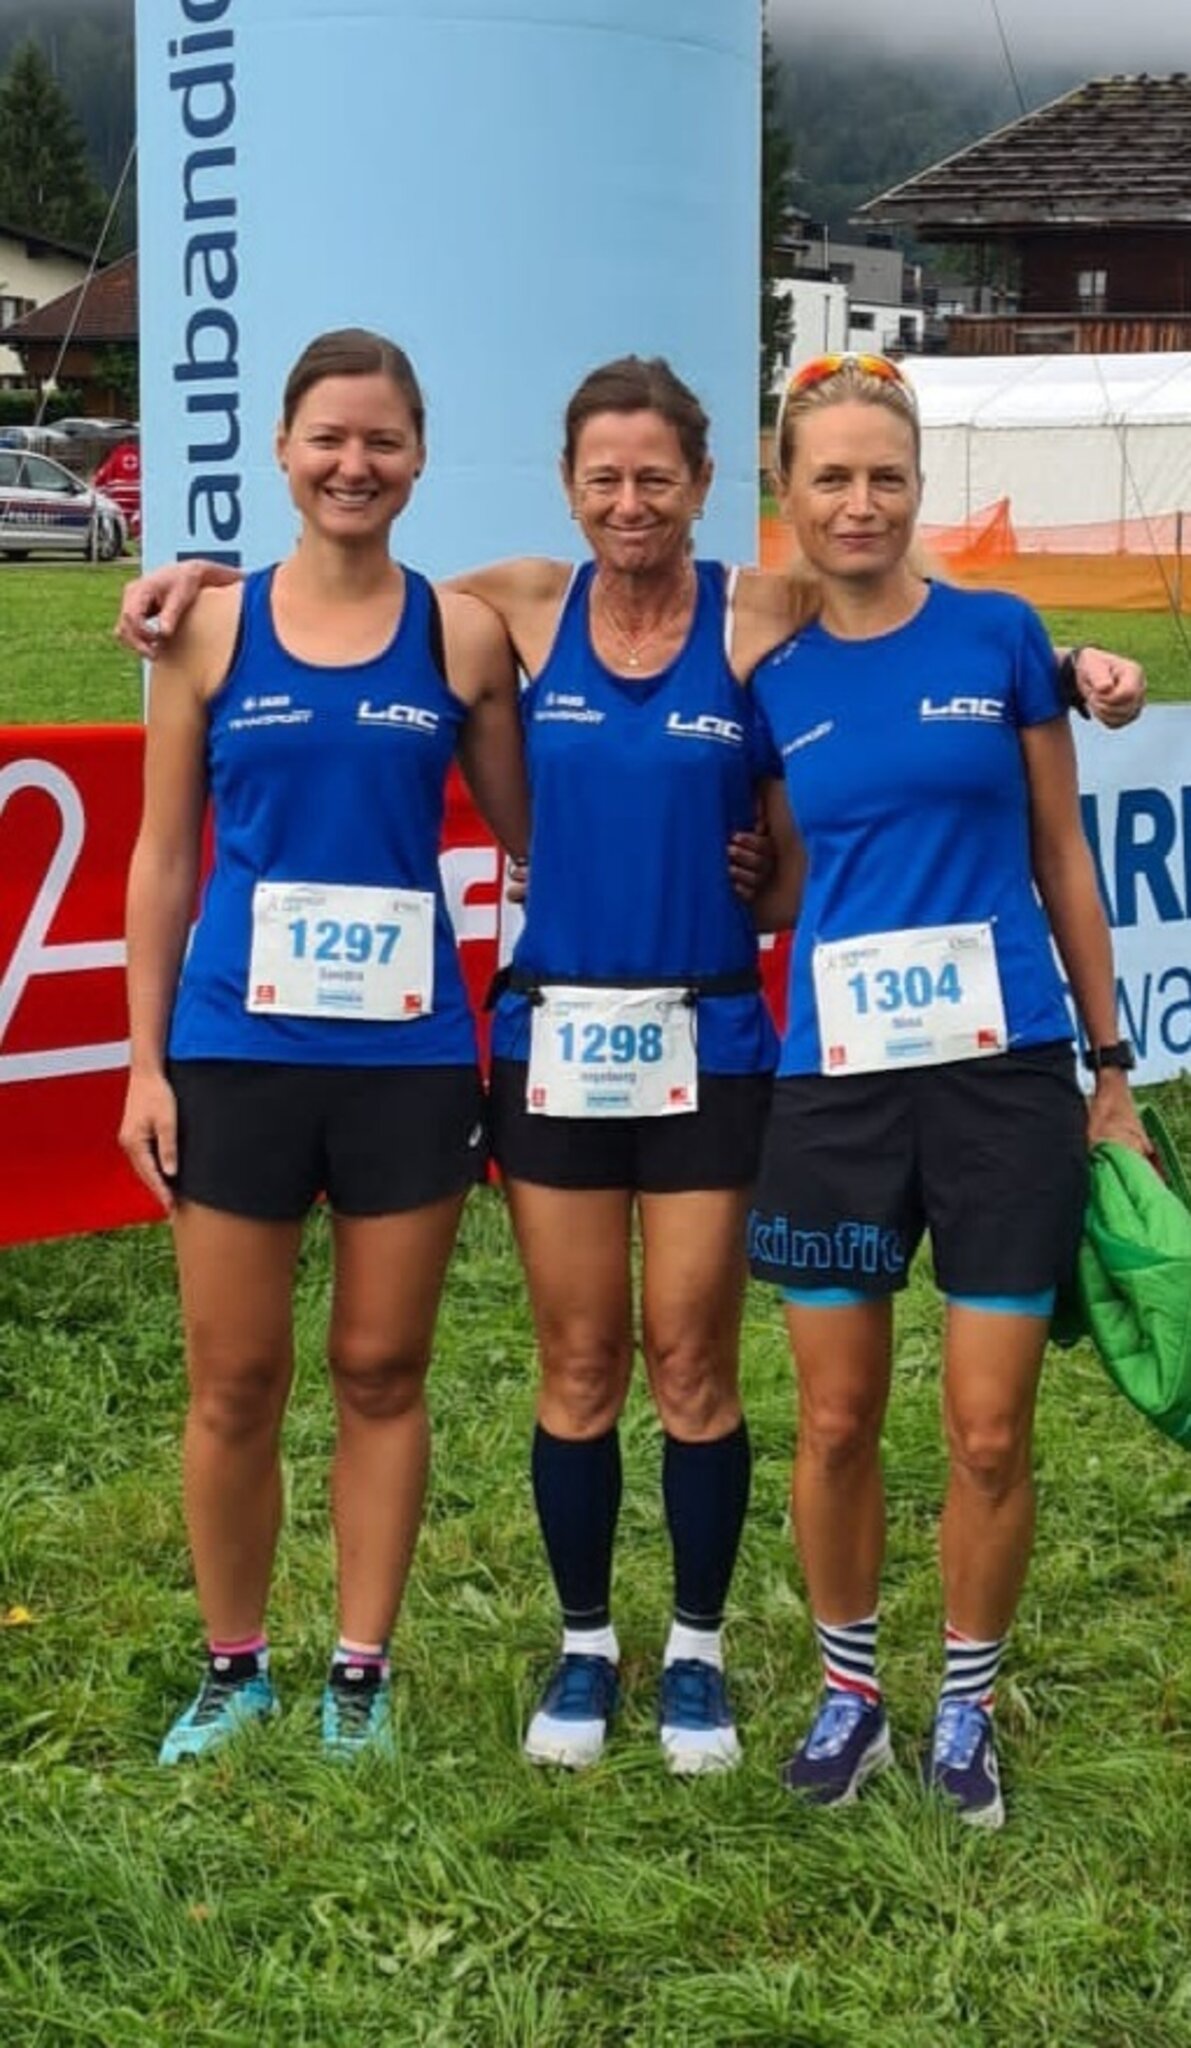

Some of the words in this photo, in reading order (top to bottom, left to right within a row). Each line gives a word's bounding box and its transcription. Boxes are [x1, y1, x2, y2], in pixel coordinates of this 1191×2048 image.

[288, 918, 401, 965] 1297
[848, 962, 962, 1014] 1304
[557, 1022, 664, 1064] 1298
